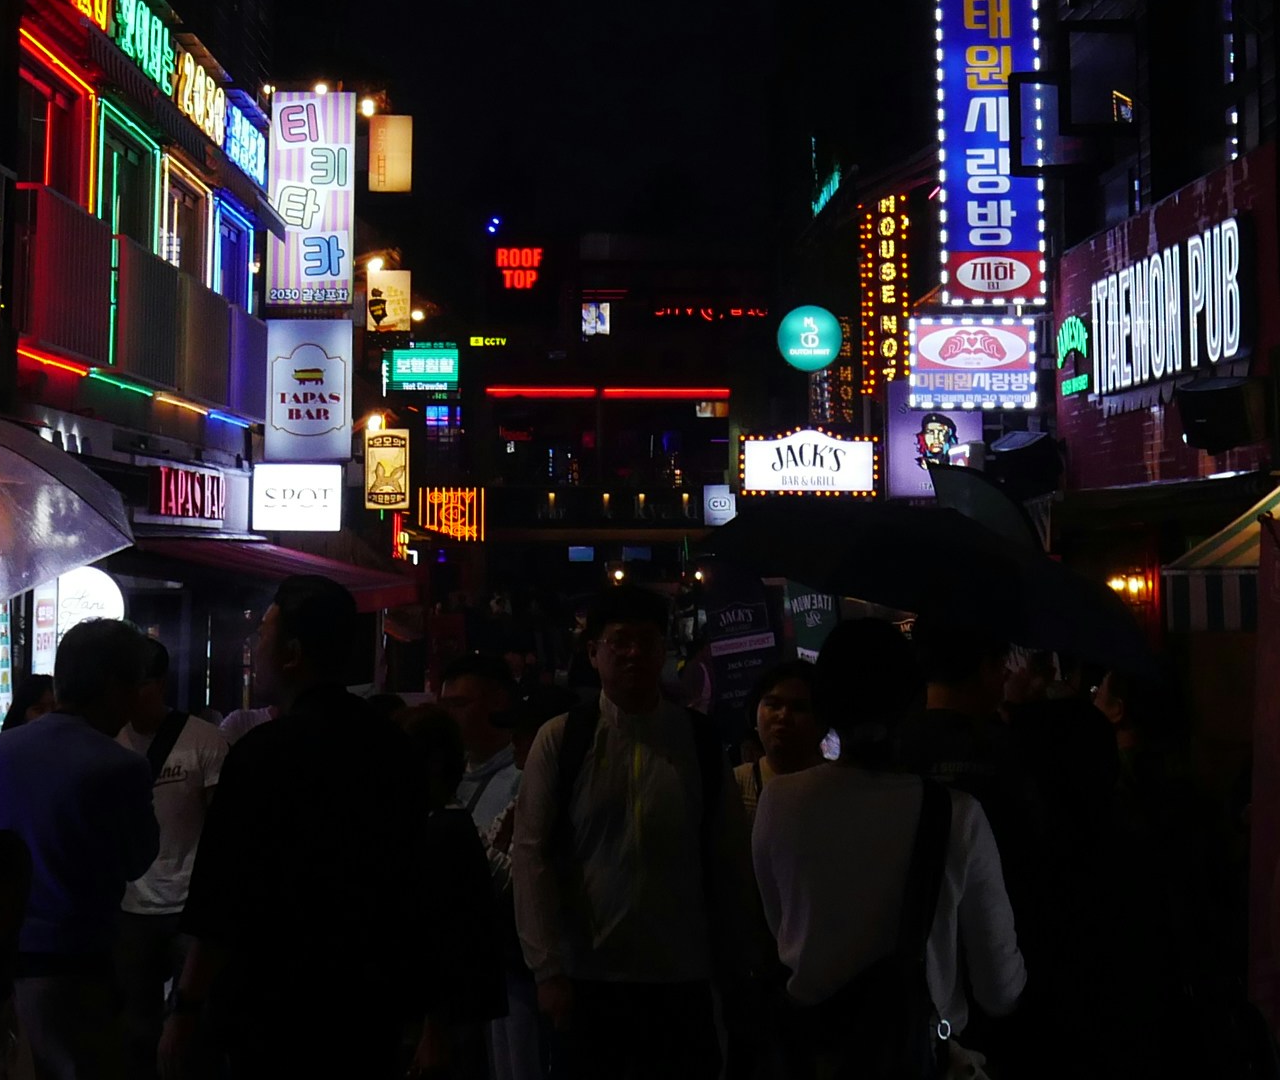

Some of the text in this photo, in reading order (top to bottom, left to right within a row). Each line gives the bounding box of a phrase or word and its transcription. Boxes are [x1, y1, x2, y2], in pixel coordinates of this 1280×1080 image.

[182, 52, 226, 146] 2030
[277, 103, 349, 277] 티키타카
[497, 248, 542, 267] ROOF
[878, 195, 897, 304] HOUSE
[503, 270, 538, 289] TOP
[270, 288, 299, 301] 2030
[1091, 217, 1241, 396] ITAEWON PUB
[485, 337, 507, 346] CCTV
[417, 382, 448, 391] Crowded
[276, 392, 341, 405] TAPAS
[288, 408, 330, 421] BAR
[771, 442, 847, 472] JACK'S
[781, 475, 836, 487] BAR & GRILL
[160, 466, 226, 521] TAPAS BAR
[264, 488, 334, 508] SPOT
[711, 499, 727, 509] CU
